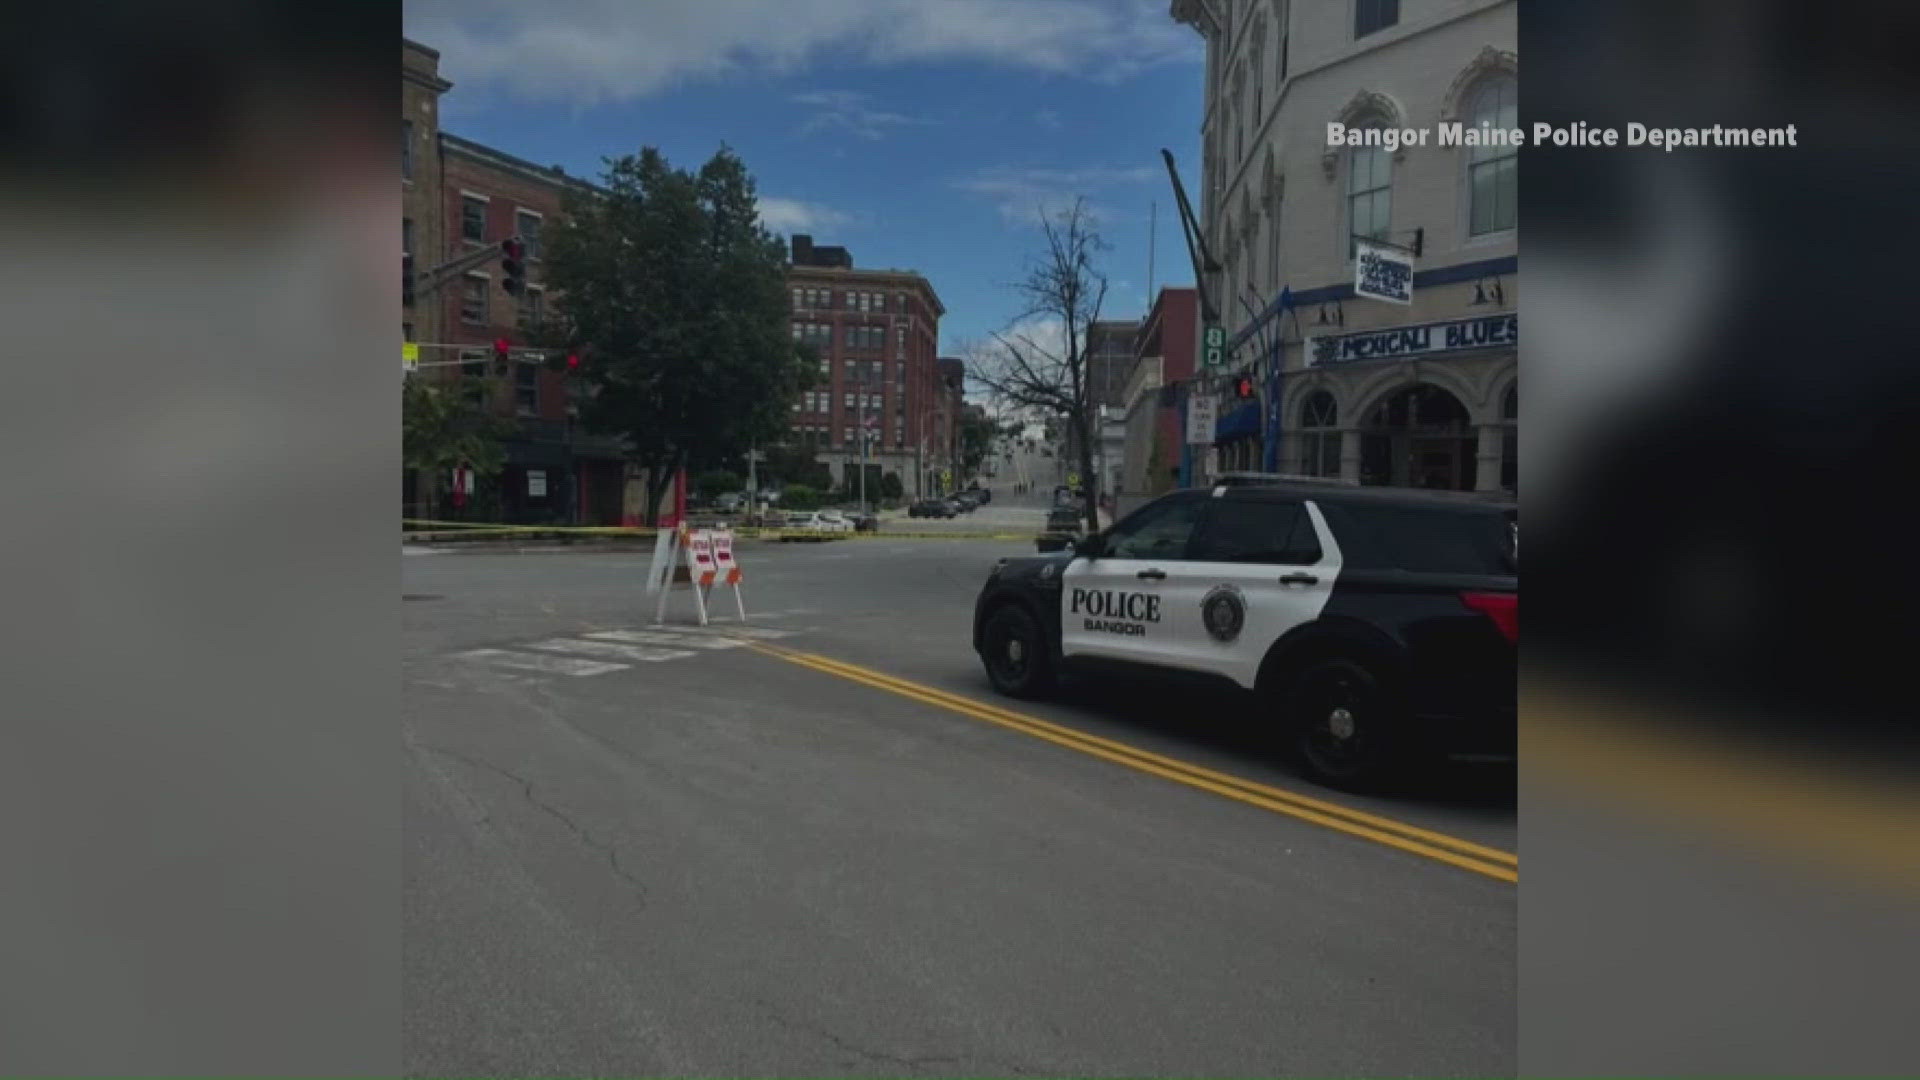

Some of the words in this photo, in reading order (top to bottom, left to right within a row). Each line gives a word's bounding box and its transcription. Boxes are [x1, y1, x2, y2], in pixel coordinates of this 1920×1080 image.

[1343, 327, 1430, 358] MEXICALI
[1072, 588, 1161, 622] POLICE
[1084, 619, 1146, 636] BANGOR
